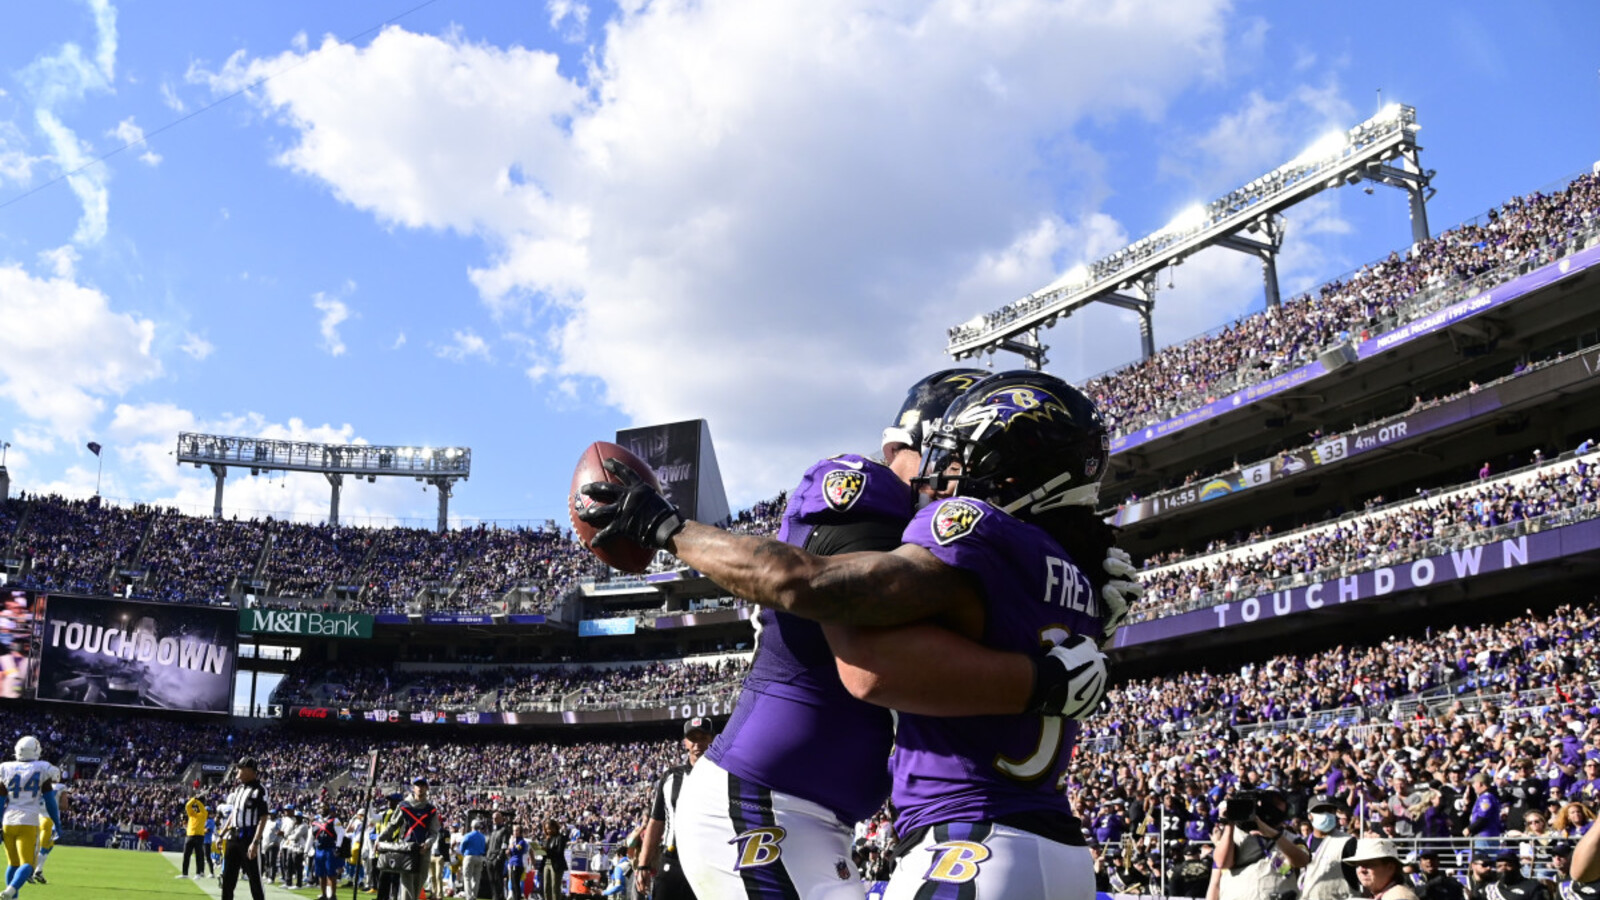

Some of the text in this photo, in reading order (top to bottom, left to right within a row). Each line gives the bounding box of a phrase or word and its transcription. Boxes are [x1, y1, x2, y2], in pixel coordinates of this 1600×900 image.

[1377, 329, 1410, 348] MICHAEL
[1163, 488, 1196, 510] 14:55
[1252, 469, 1262, 483] 6
[1324, 441, 1344, 460] 33
[1378, 421, 1408, 442] QTR
[1213, 535, 1529, 629] TOUCHDOWN
[252, 610, 360, 636] M&T Bank
[50, 619, 228, 675] TOUCHDOWN
[668, 700, 732, 719] TOUCH
[7, 771, 41, 798] 44
[728, 826, 787, 871] B
[925, 840, 992, 884] B
